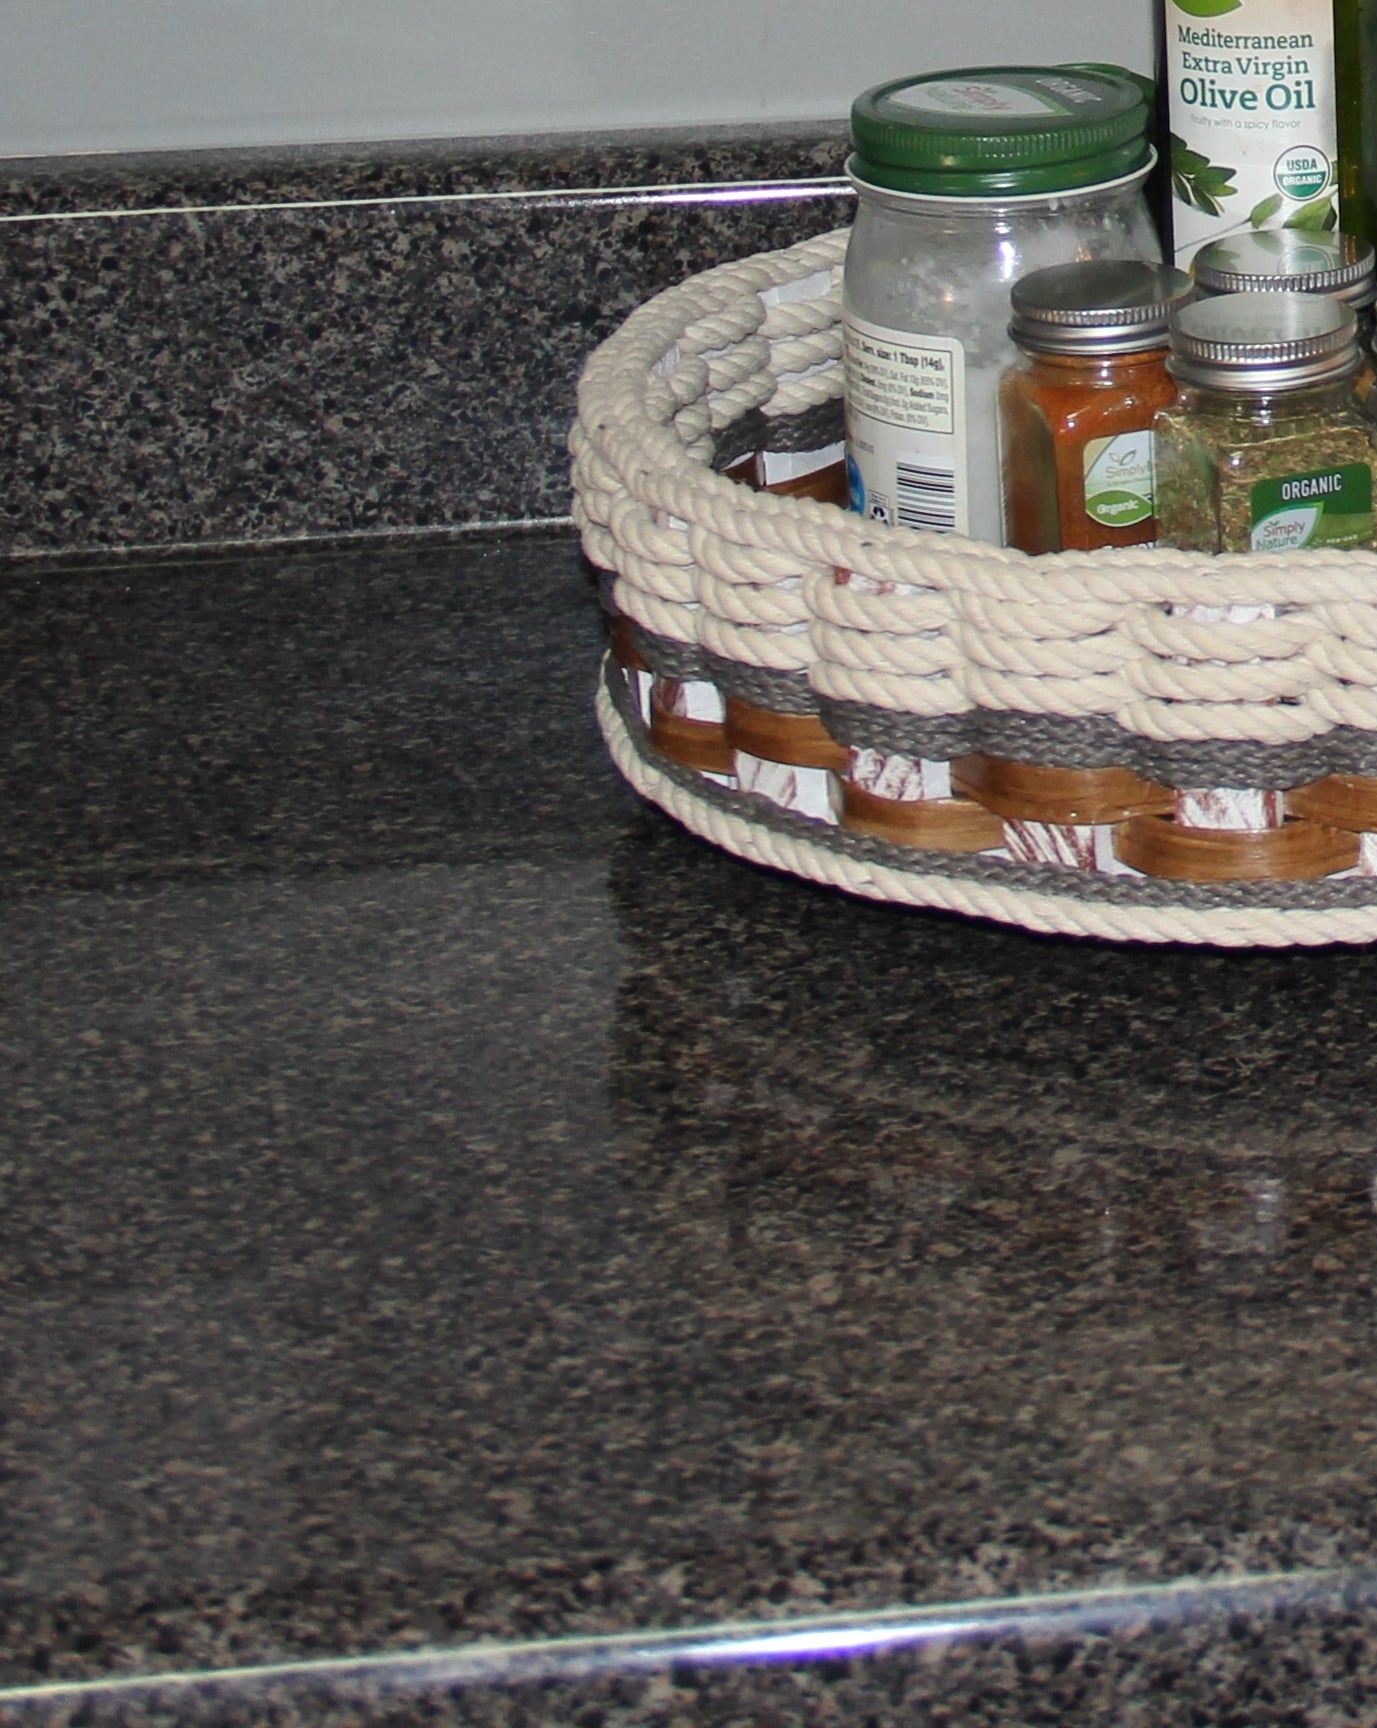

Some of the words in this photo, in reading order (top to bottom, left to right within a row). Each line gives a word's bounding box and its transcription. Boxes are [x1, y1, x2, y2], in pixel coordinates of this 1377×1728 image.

[1177, 24, 1314, 50] Mediterranean
[1182, 51, 1233, 75] Extra
[1235, 55, 1310, 81] Virgin
[1180, 77, 1258, 111] Olive
[1265, 80, 1316, 111] Oil
[1214, 118, 1234, 128] with
[1235, 120, 1243, 129] a
[1243, 120, 1269, 131] spicy
[1286, 158, 1318, 171] USDA
[1282, 174, 1322, 186] ORGANIC
[1282, 474, 1342, 500] ORGANIC
[1097, 500, 1139, 515] Organic
[1263, 521, 1306, 537] Simply
